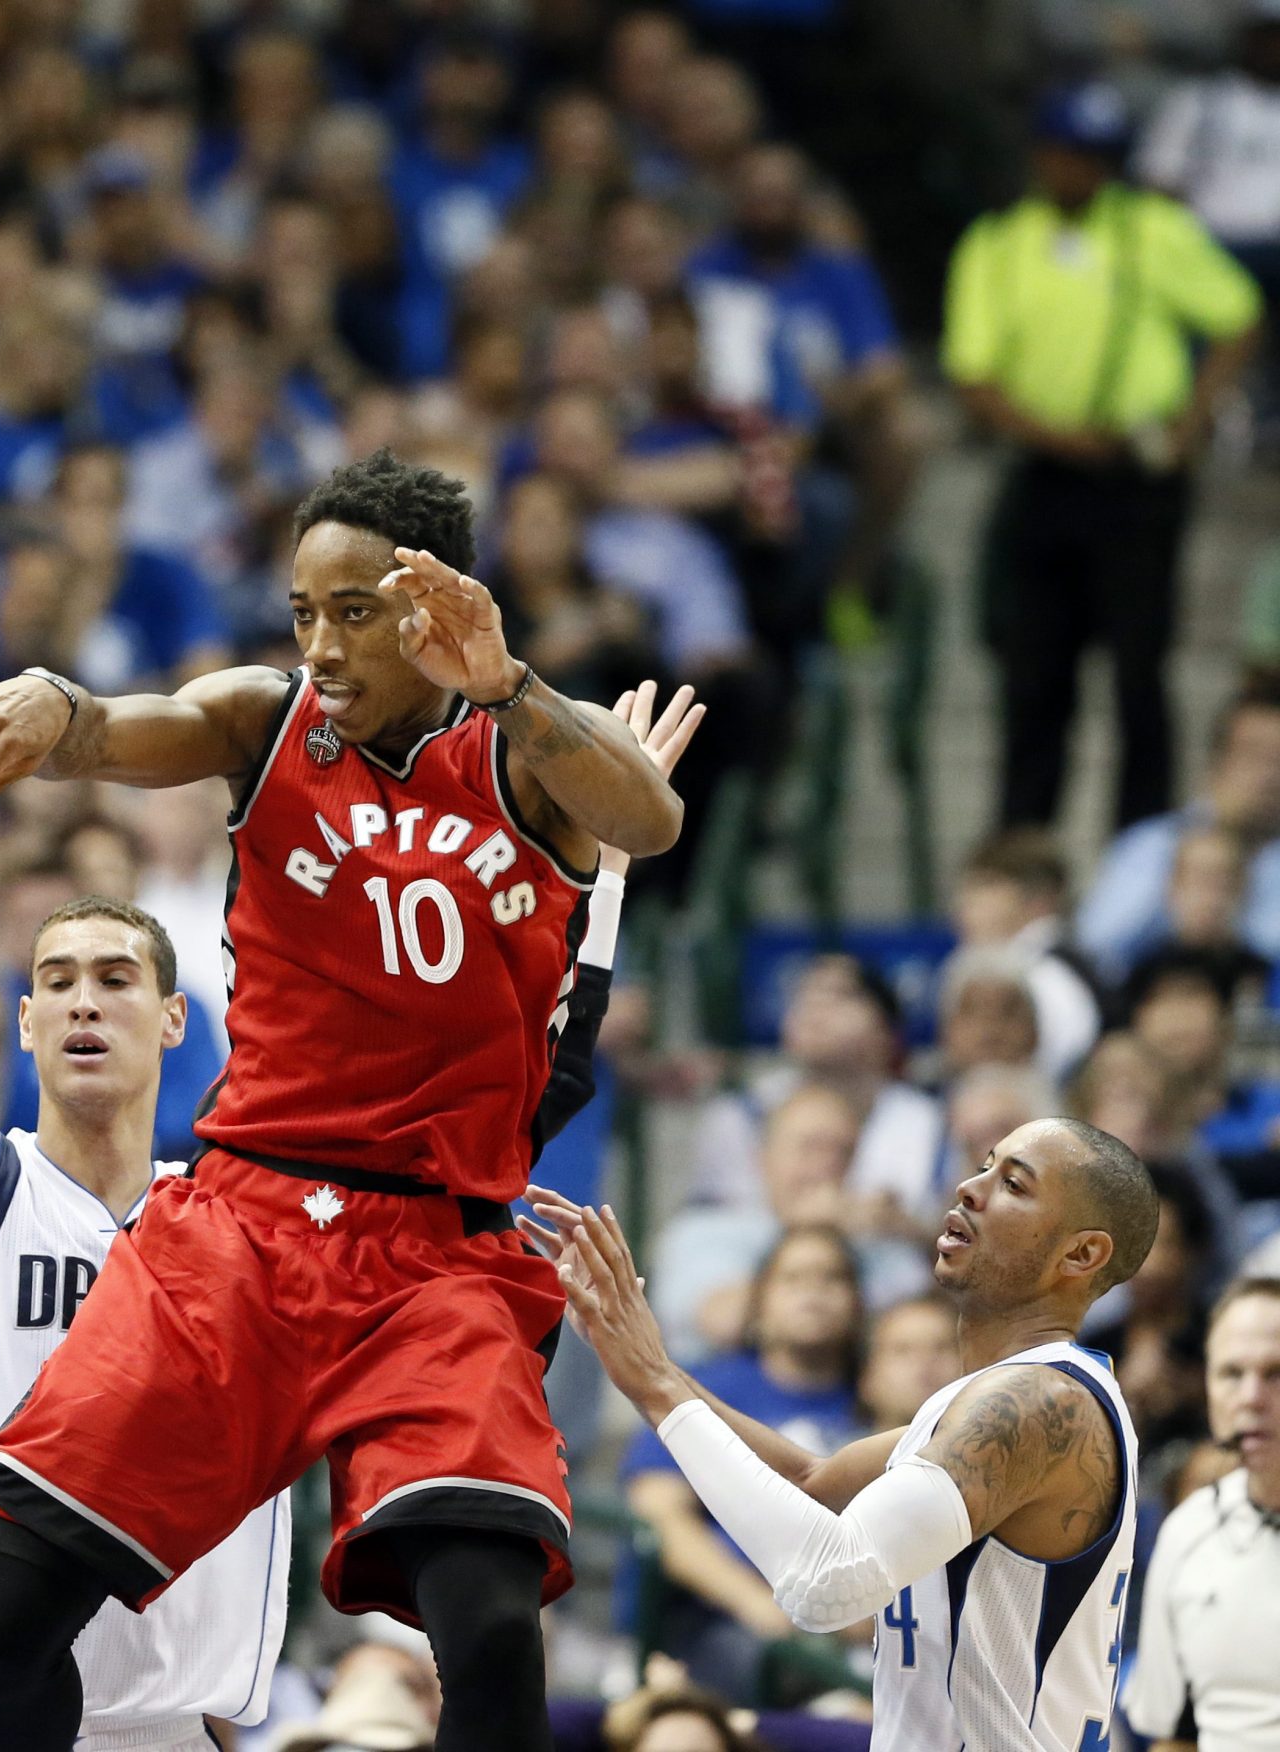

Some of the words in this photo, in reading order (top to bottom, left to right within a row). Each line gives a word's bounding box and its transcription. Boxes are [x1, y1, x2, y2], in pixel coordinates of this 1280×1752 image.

[283, 803, 537, 926] RAPTORS
[362, 876, 464, 984] 10
[15, 1254, 99, 1330] DA
[872, 1584, 920, 1672] 4
